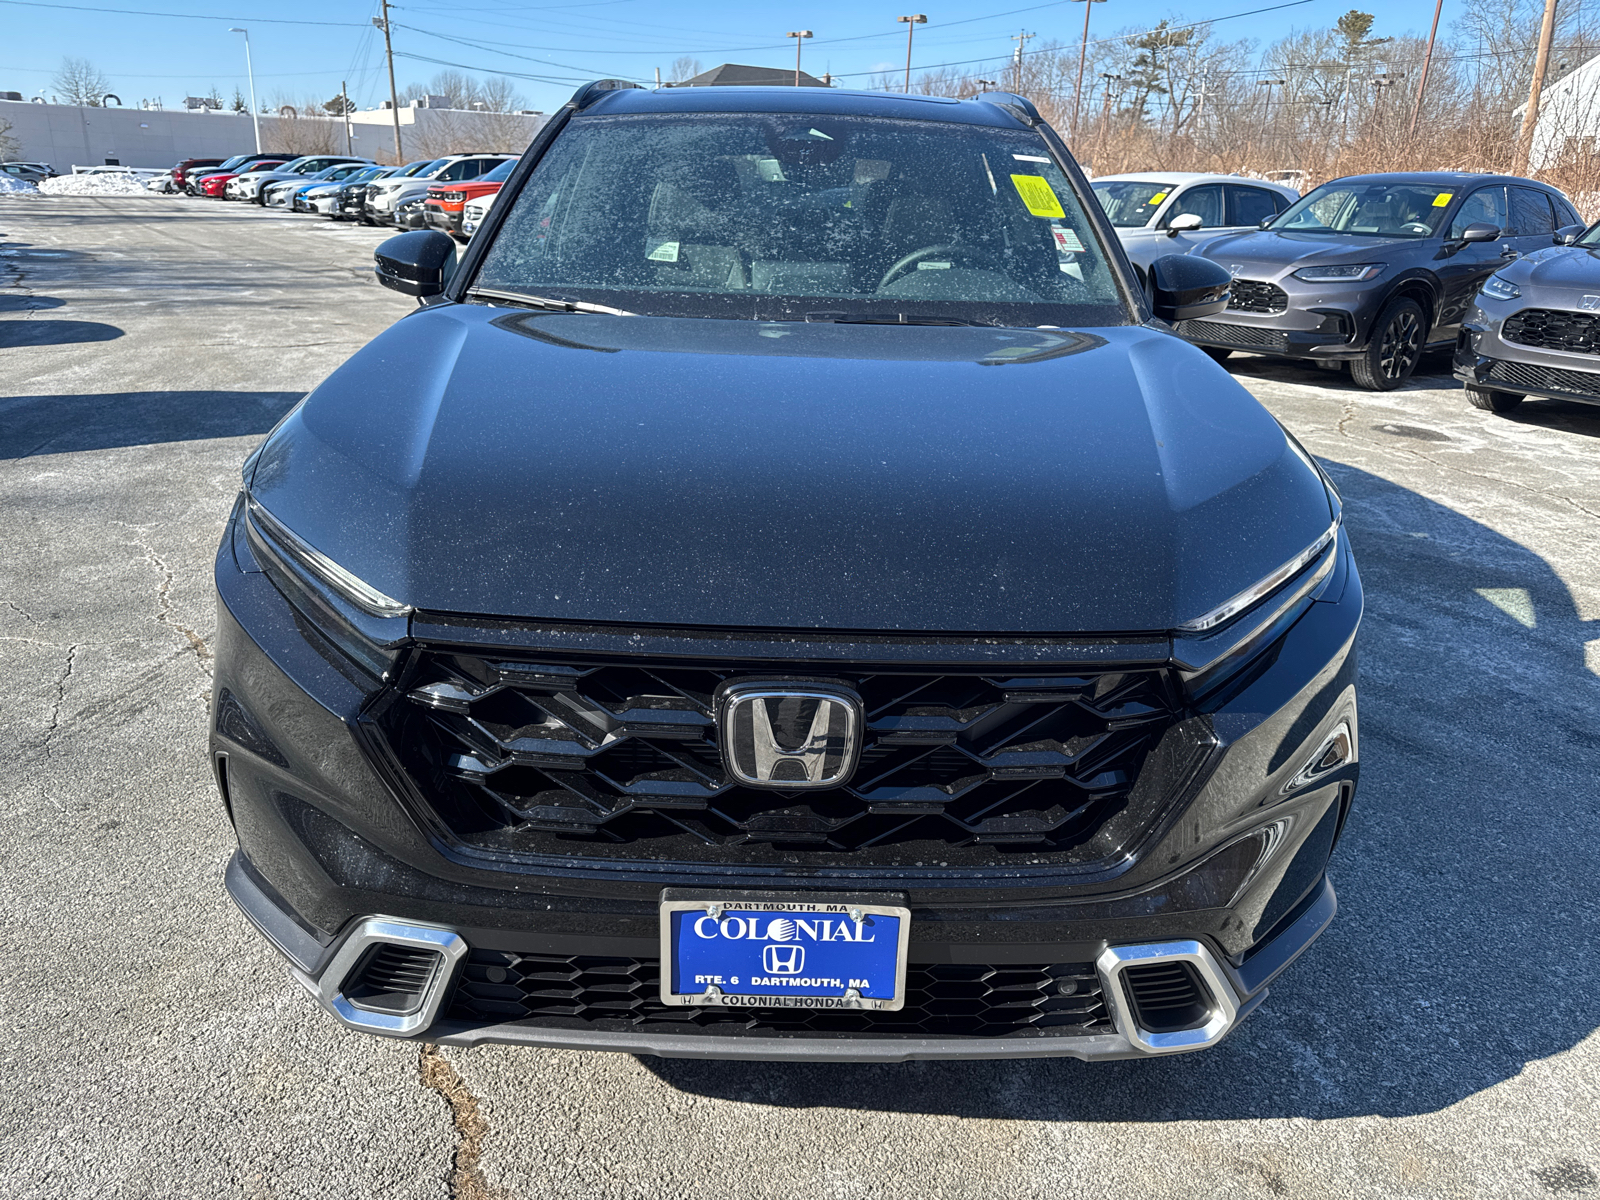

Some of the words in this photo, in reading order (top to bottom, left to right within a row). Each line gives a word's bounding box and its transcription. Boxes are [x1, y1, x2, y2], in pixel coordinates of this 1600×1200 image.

[723, 902, 821, 912] DARTMOUTH,
[826, 904, 848, 912] MA
[694, 916, 875, 943] COLONIAL
[695, 975, 727, 985] RTE.
[730, 976, 740, 985] 6
[751, 976, 845, 989] DARTMOUTH,
[848, 979, 870, 988] MA
[721, 995, 790, 1008] COLONIAL
[794, 998, 844, 1009] HONDA
